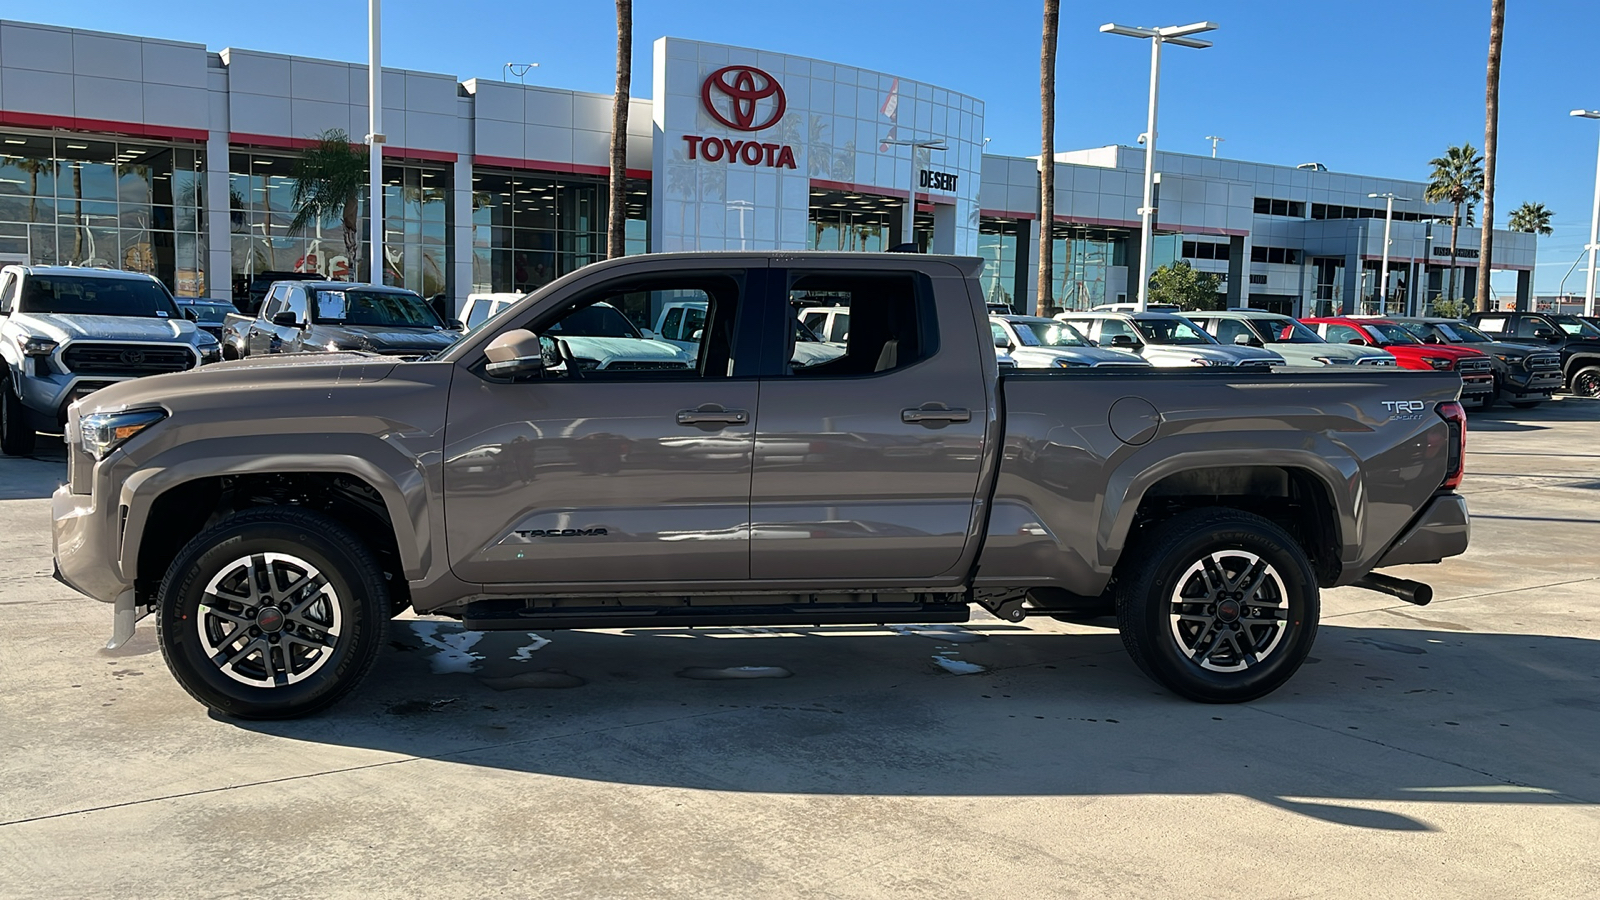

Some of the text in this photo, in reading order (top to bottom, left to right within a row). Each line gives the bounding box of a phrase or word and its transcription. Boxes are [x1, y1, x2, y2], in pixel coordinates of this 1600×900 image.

[682, 135, 797, 169] TOYOTA
[920, 169, 958, 192] DESERT
[1381, 400, 1424, 413] TRD
[514, 528, 608, 538] TACOMA
[1236, 532, 1281, 551] MICHELIN
[173, 563, 200, 617] MICHELIN
[335, 625, 362, 676] MICHELIN
